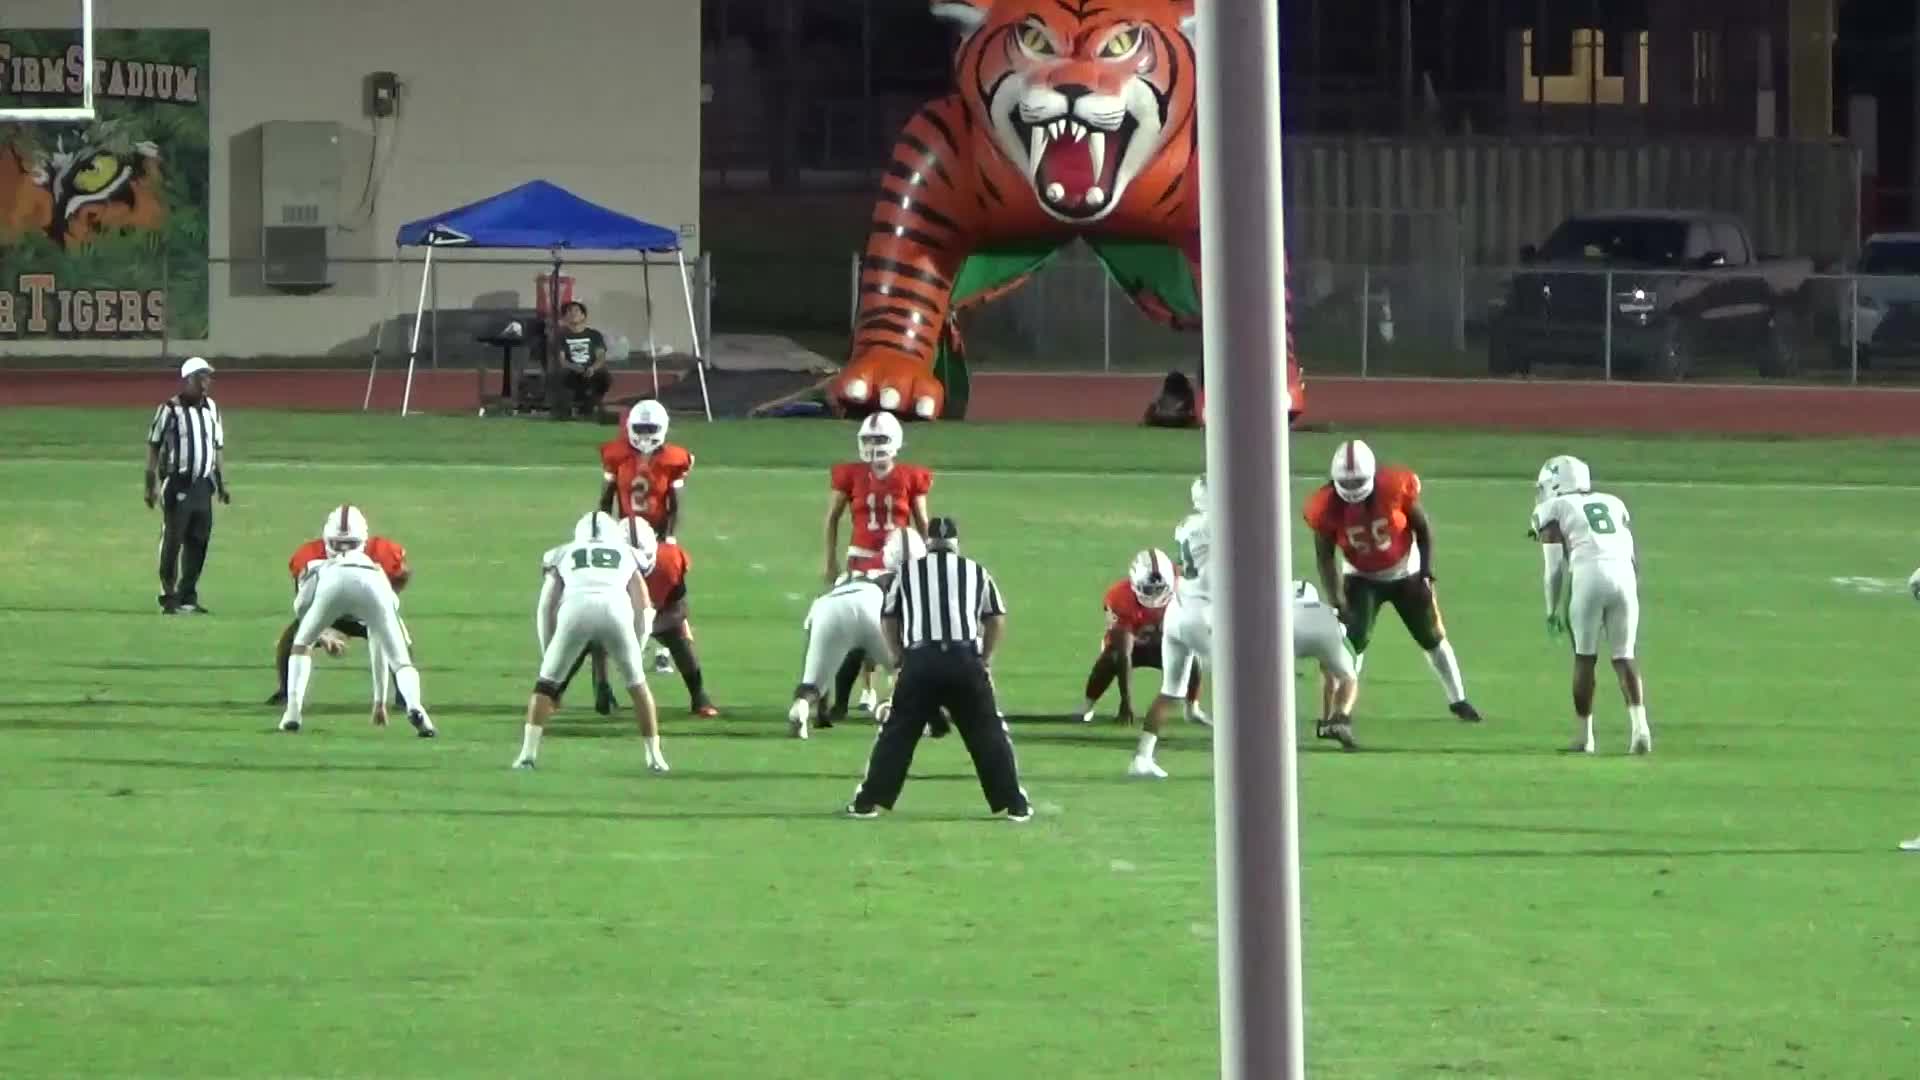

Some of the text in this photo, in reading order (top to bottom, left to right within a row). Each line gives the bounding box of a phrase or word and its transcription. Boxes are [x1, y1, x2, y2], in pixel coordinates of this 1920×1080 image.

[631, 475, 649, 511] 2
[867, 493, 895, 530] 11
[1583, 502, 1616, 535] 8
